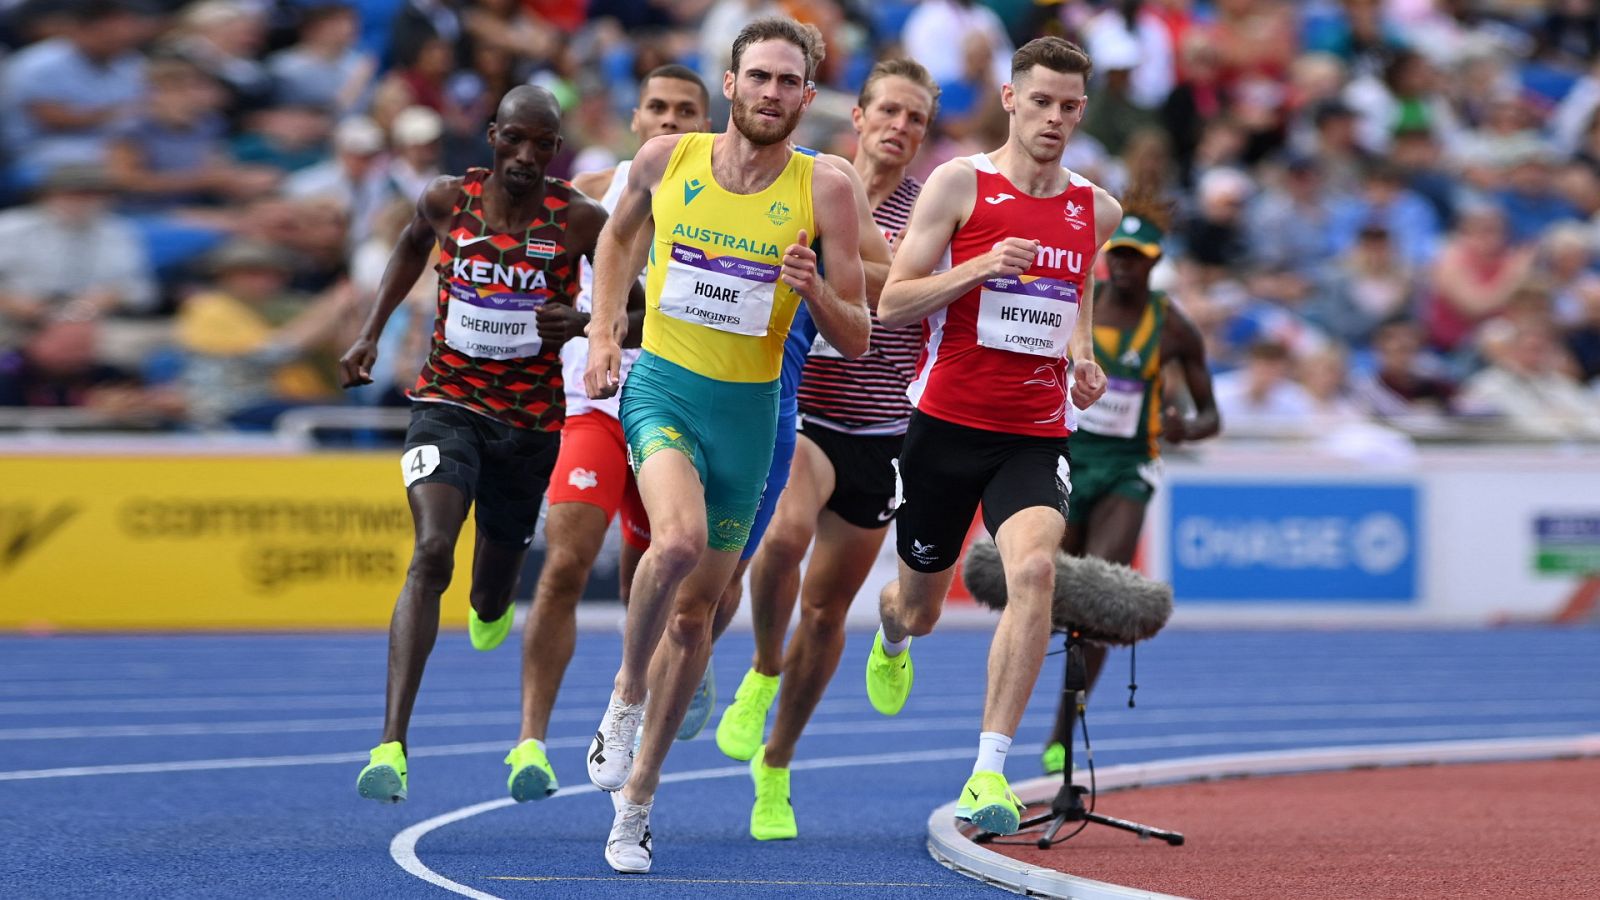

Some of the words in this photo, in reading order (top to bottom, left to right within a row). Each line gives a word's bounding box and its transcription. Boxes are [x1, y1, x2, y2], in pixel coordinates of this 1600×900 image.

[672, 224, 778, 258] AUSTRALIA
[1037, 245, 1082, 273] mru
[453, 257, 548, 289] KENYA
[694, 281, 740, 303] HOARE
[461, 315, 527, 335] CHERUIYOT
[685, 306, 740, 324] LONGINES
[1001, 306, 1061, 327] HEYWARD
[466, 341, 518, 354] LONGINES
[1005, 334, 1054, 349] LONGINES
[411, 449, 426, 474] 4
